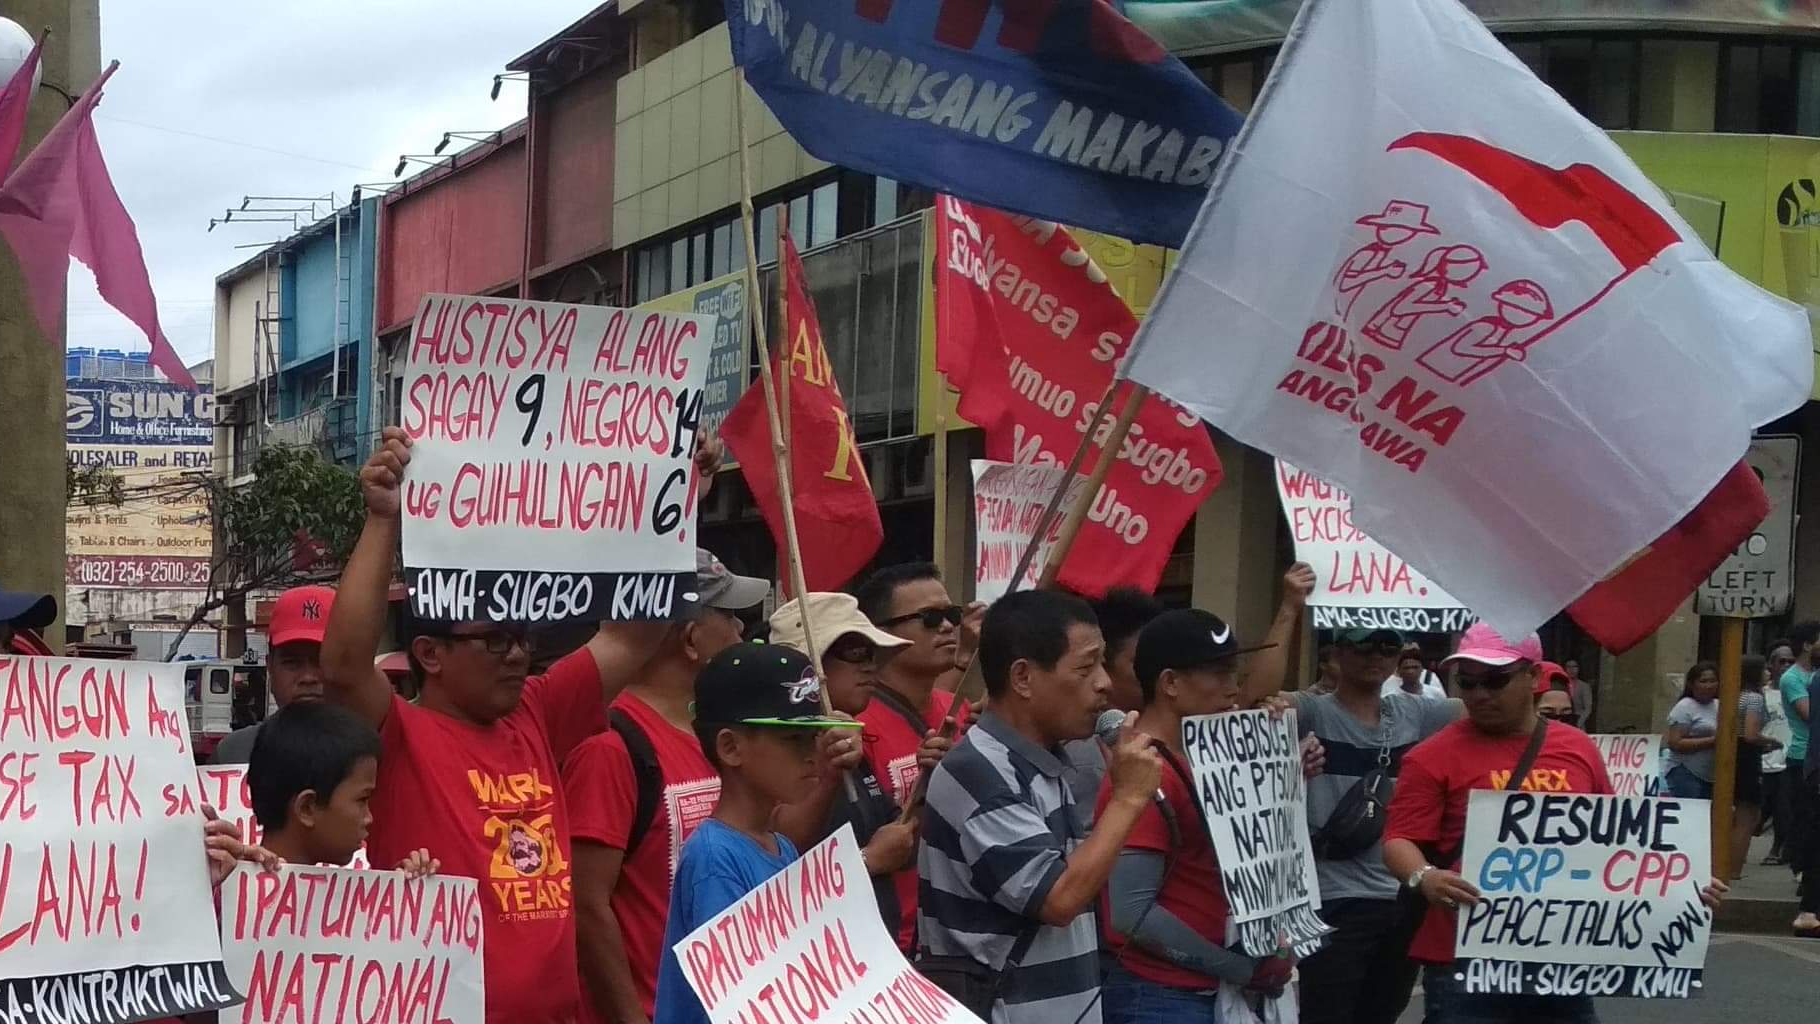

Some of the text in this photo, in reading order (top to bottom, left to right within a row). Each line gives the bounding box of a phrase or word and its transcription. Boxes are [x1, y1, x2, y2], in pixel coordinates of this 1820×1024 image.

[791, 21, 1037, 143] ALYANSANG
[1032, 100, 1235, 187] MAKAB
[411, 298, 698, 381] HUSTISYA ALANG
[721, 350, 741, 377] COLD
[109, 391, 184, 419] SUN
[110, 421, 135, 436] Home
[136, 422, 145, 436] &
[145, 422, 170, 436] Office
[405, 371, 510, 442] SAGAY
[560, 376, 674, 455] NEGROS
[671, 388, 705, 460] 14
[1376, 376, 1467, 447] NA
[144, 453, 167, 467] and
[1118, 422, 1207, 494] Sugbo
[449, 459, 649, 534] GUIHULNGAN
[1087, 483, 1149, 545] Uno
[117, 536, 146, 547] Chairs
[157, 537, 193, 547] Outdoor
[1708, 570, 1776, 589] LEFT
[1708, 595, 1776, 614] TURN
[58, 750, 143, 827] TAX
[163, 782, 196, 818] SA
[1203, 765, 1247, 816] ANG
[1497, 793, 1682, 852] RESUME
[492, 876, 572, 913] YEARS
[1480, 847, 1565, 895] GRP
[1603, 849, 1691, 897] CPP
[235, 870, 481, 958] IPATUMAN ANG
[685, 836, 846, 1011] IPATUMAN ANG
